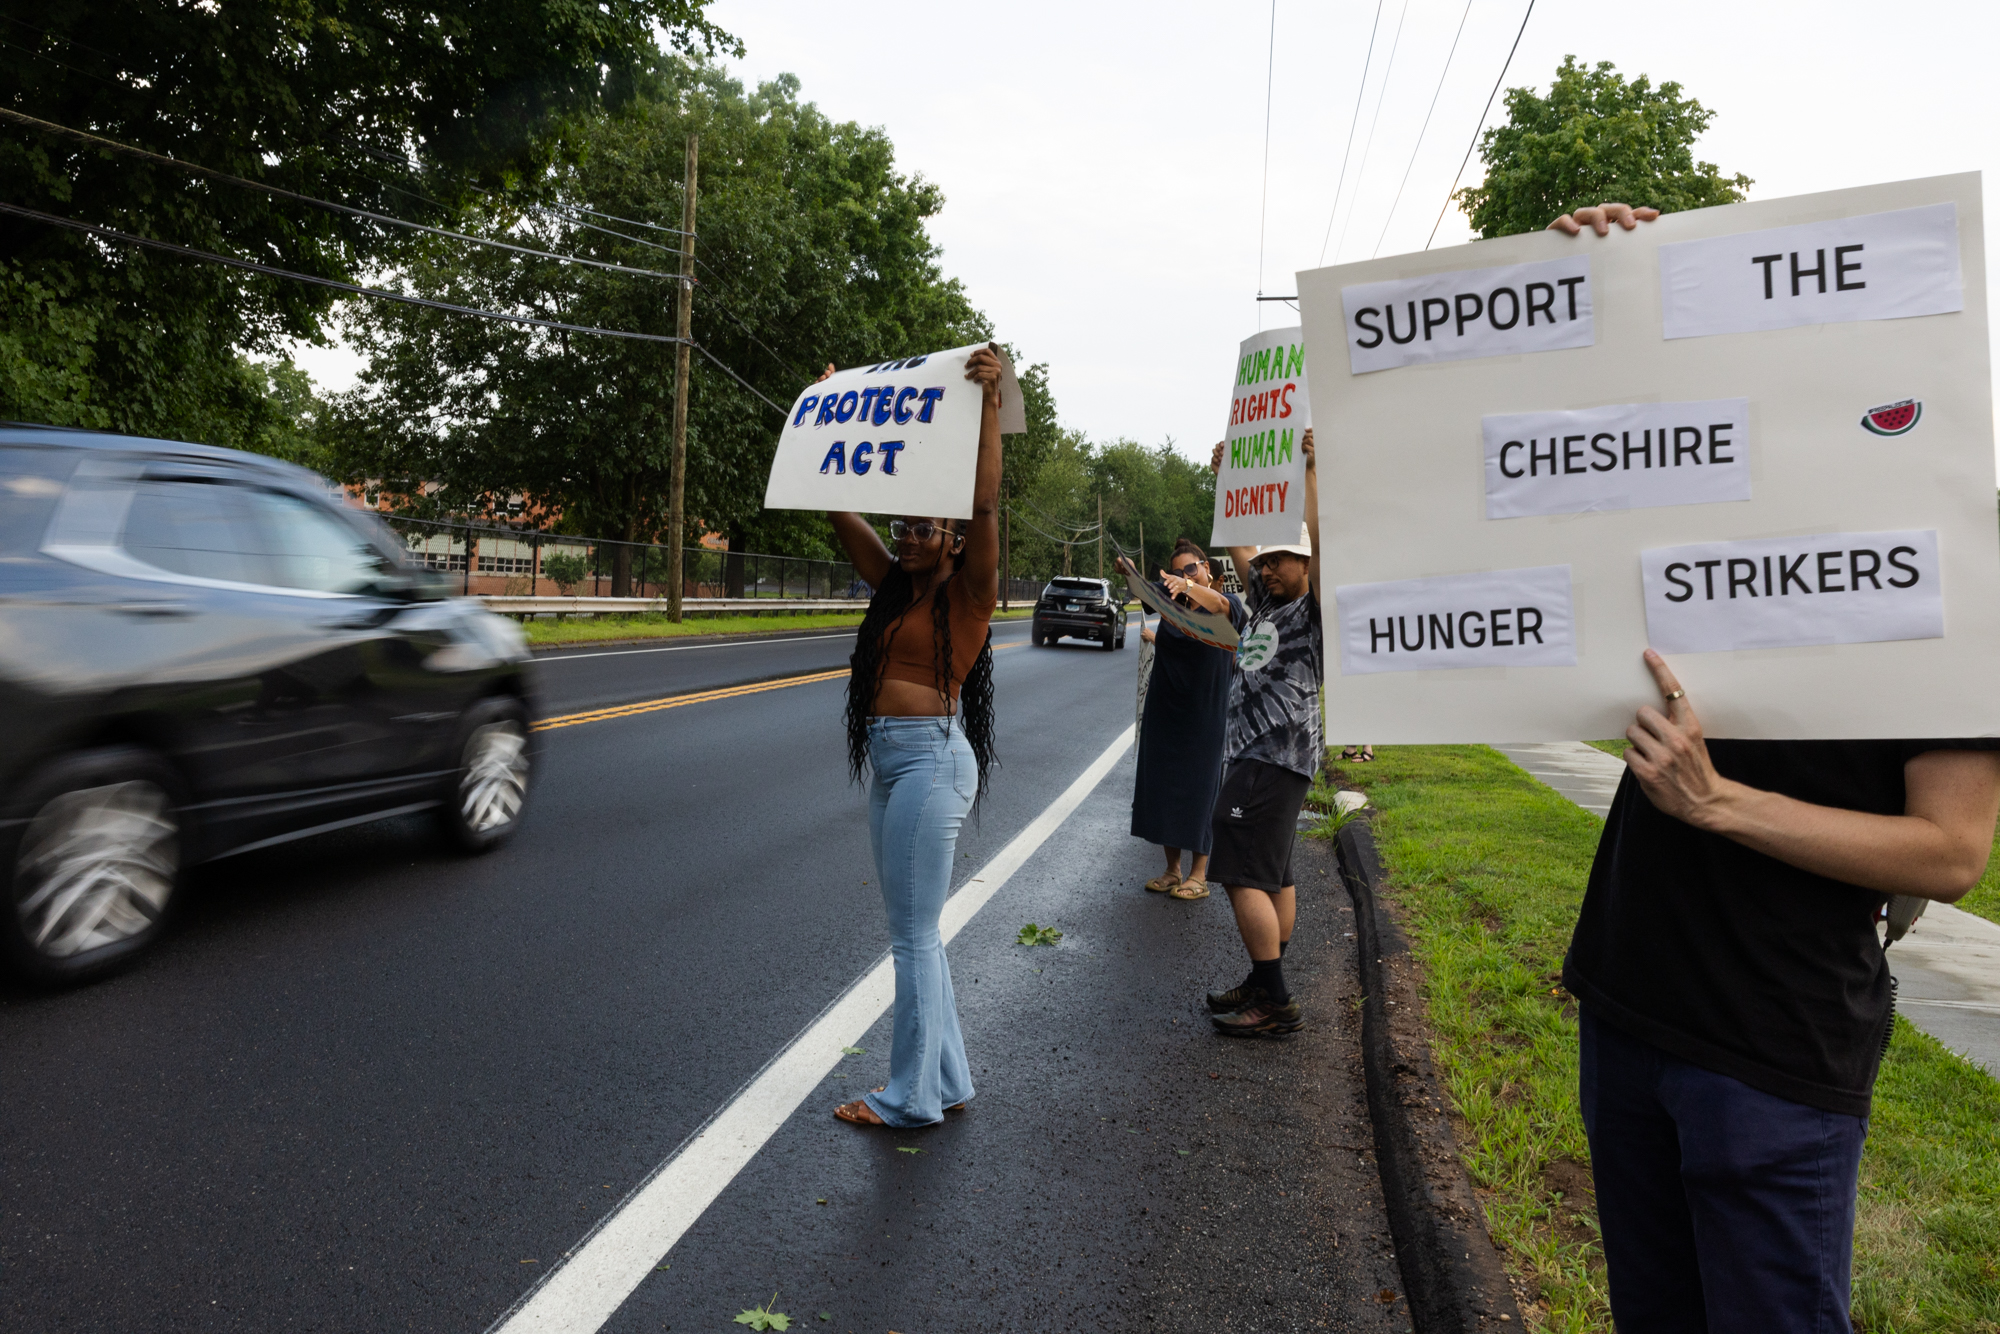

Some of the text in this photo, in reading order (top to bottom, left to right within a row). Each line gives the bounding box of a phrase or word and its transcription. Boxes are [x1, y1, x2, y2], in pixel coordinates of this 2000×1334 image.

[1354, 243, 1866, 349] SUPPORT THE
[1237, 342, 1305, 387] HUMAN
[792, 385, 946, 430] PROTECT
[1230, 382, 1297, 426] RIGHTS
[818, 440, 905, 476] ACT
[1230, 427, 1294, 469] HUMAN
[1499, 423, 1735, 479] CHESHIRE
[1224, 480, 1289, 519] DIGNITY
[1369, 545, 1920, 654] HUNGER STRIKERS
